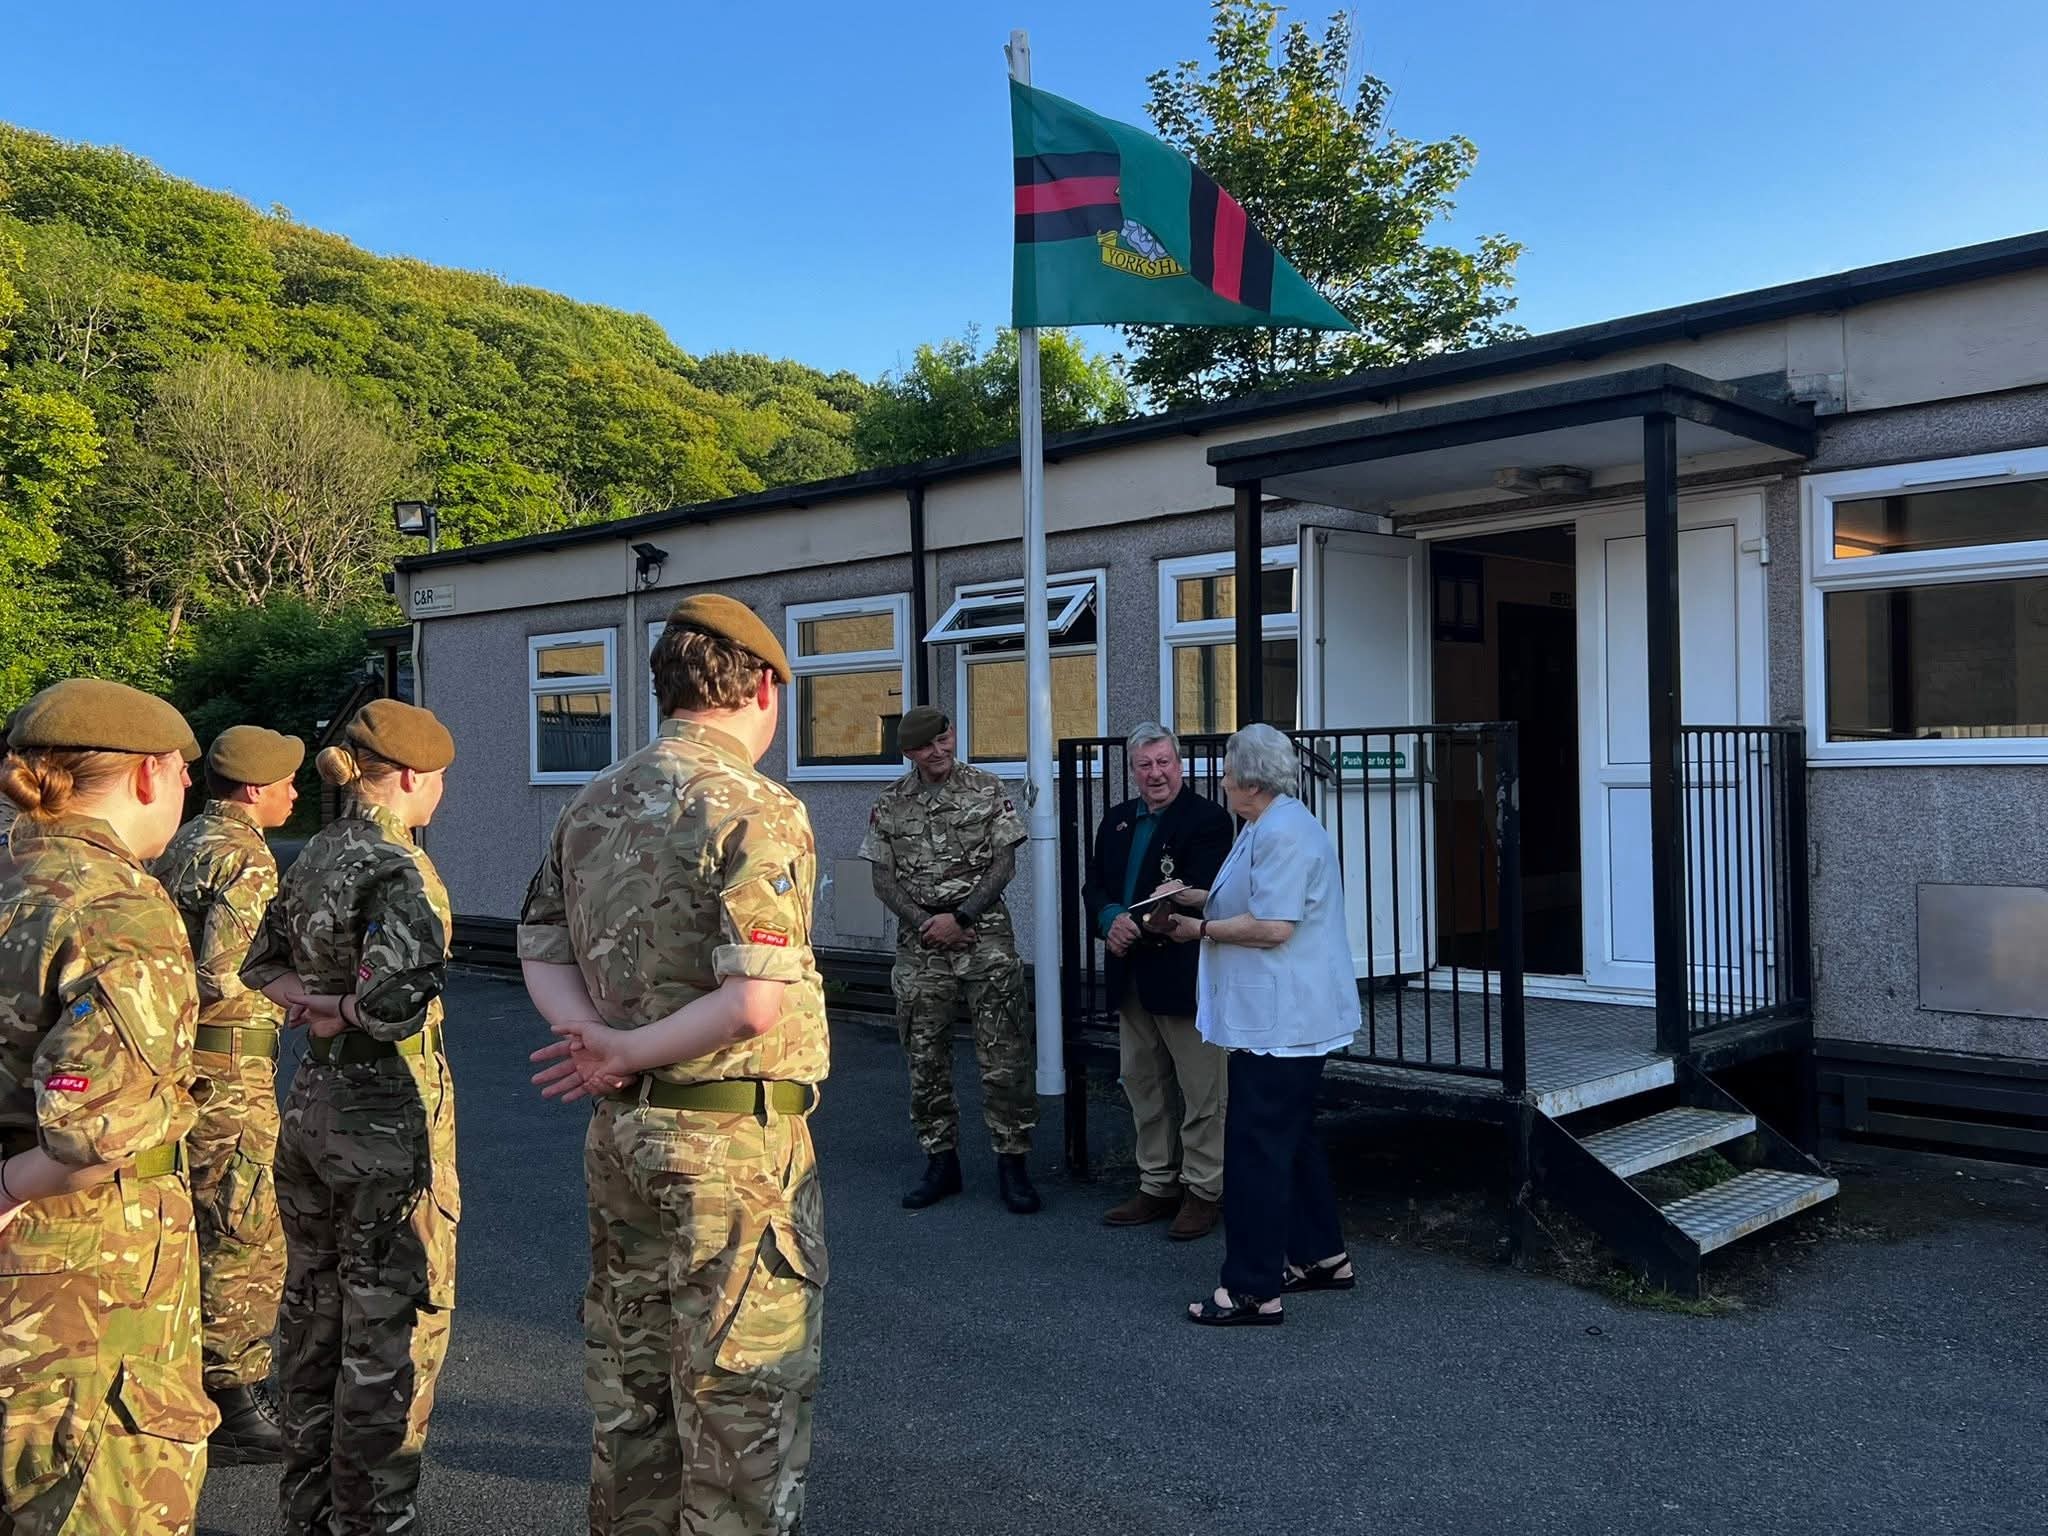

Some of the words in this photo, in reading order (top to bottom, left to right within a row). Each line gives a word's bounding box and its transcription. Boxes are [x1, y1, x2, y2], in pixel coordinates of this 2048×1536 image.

[414, 589, 434, 606] C&R
[1343, 756, 1362, 765] Push
[1377, 756, 1385, 765] to
[1385, 757, 1404, 766] oen
